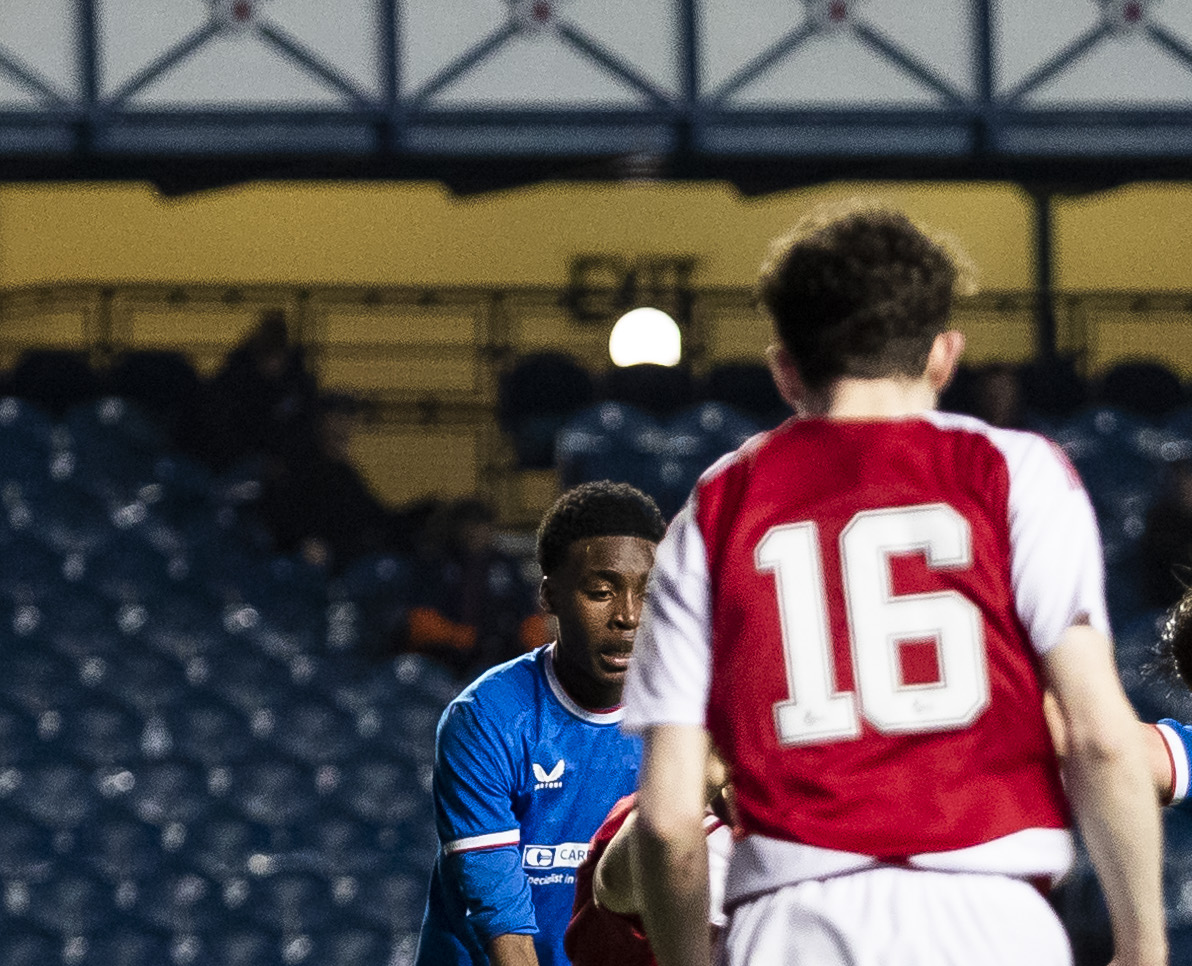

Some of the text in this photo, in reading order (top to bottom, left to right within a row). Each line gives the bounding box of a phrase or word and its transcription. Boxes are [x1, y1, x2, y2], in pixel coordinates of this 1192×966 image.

[754, 501, 993, 749] 16
[560, 848, 589, 861] CAR
[522, 872, 575, 885] pecialist in
